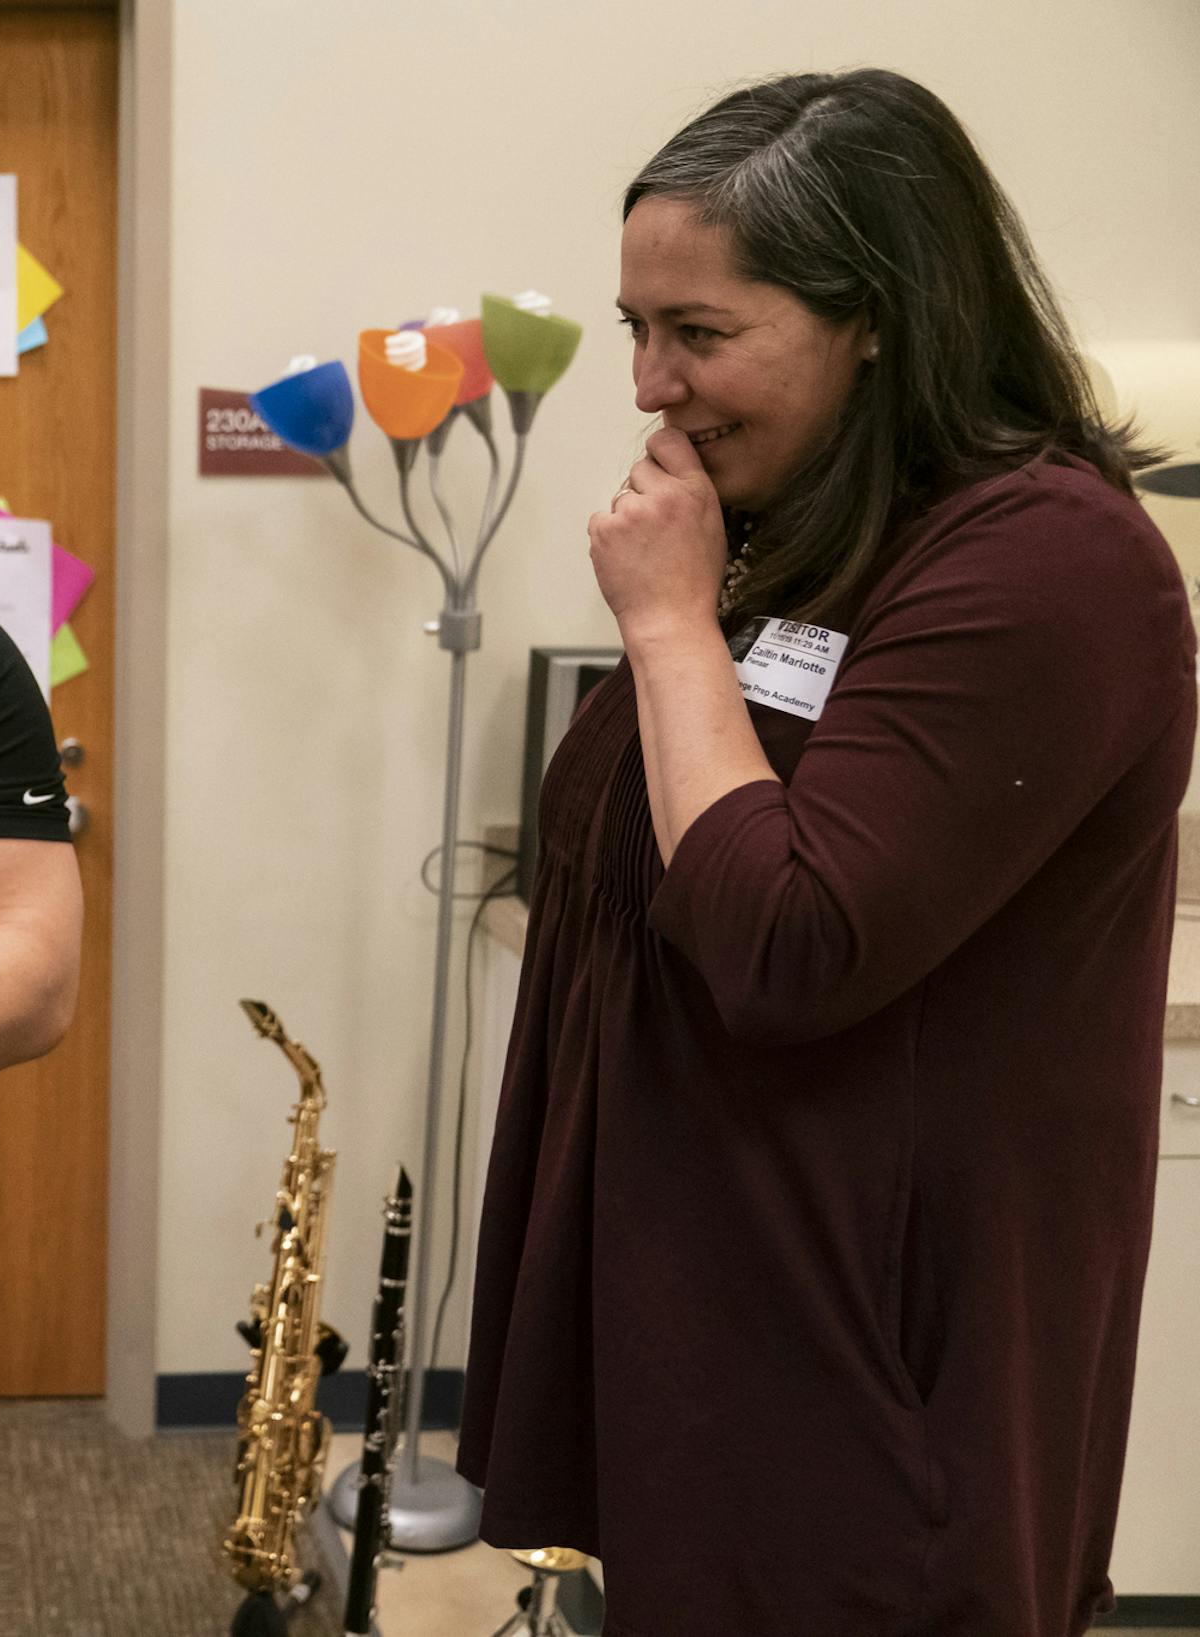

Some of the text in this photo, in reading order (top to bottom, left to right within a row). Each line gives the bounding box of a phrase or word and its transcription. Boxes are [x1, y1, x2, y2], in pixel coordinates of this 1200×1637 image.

[778, 621, 830, 643] VISITOR
[814, 644, 830, 653] AM
[753, 684, 770, 697] Prep
[771, 691, 815, 712] Academy
